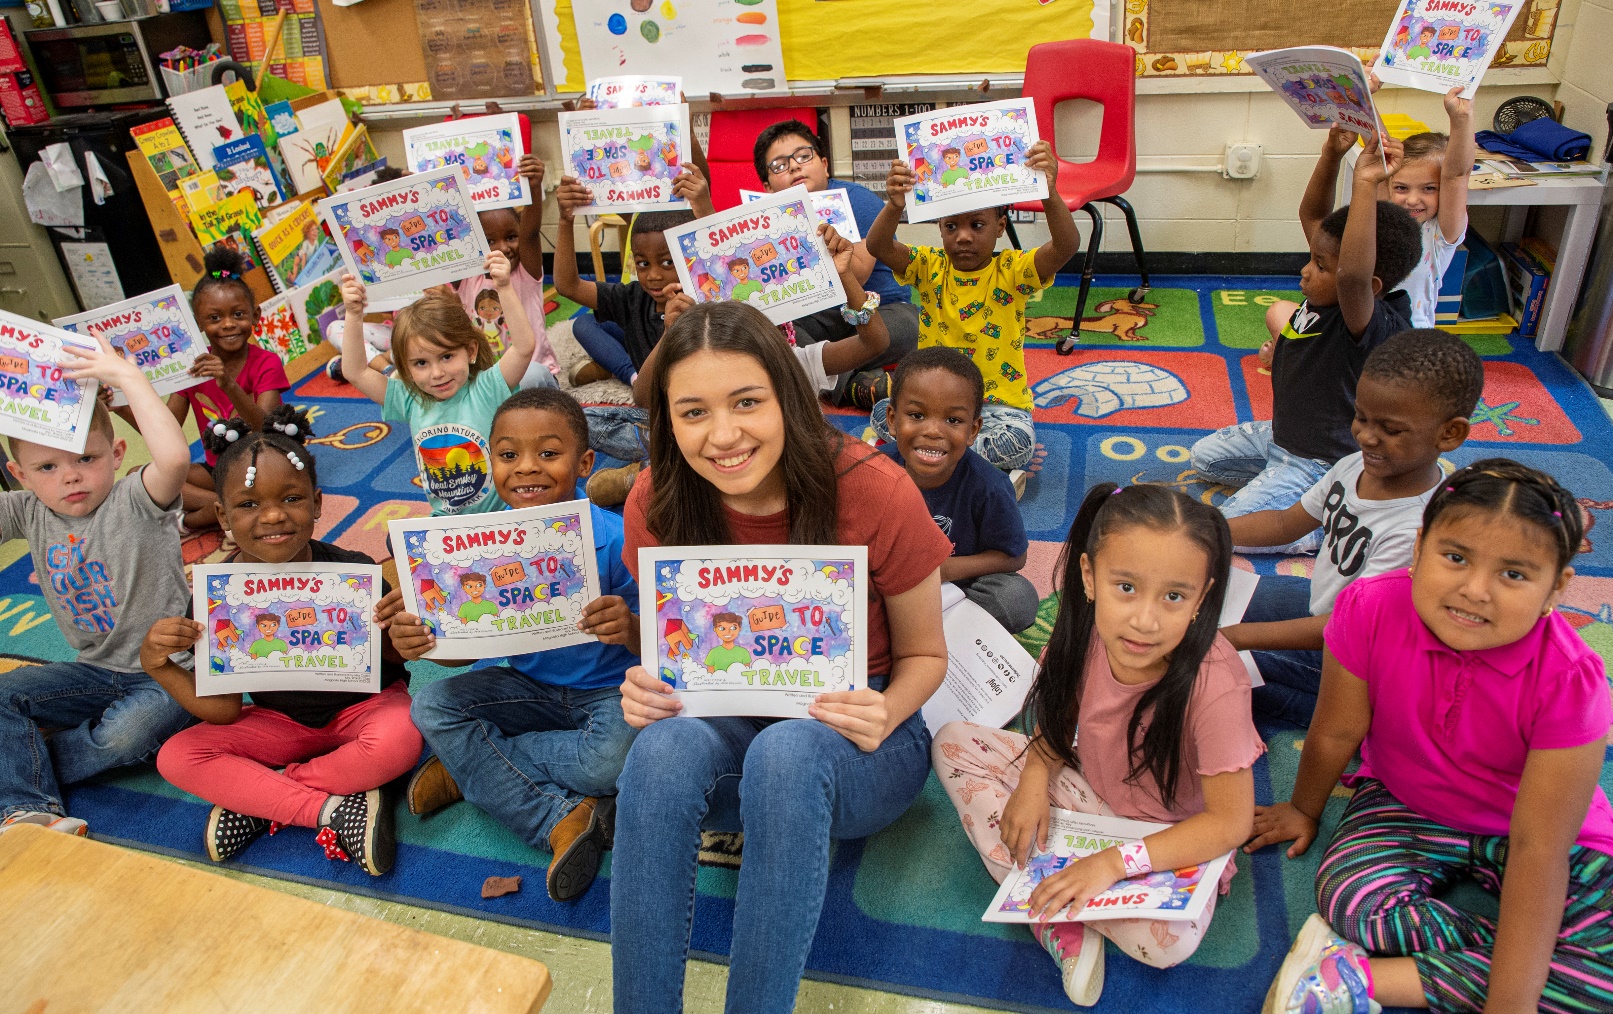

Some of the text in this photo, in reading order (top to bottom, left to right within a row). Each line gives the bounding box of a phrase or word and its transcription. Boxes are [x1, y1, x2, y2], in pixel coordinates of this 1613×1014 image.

[1425, 0, 1477, 16] SAMMY'S
[1463, 28, 1481, 41] TO
[1432, 42, 1473, 58] SPACE
[1420, 62, 1461, 76] TRAVEL
[854, 104, 931, 117] NUMBERS 1-100
[584, 127, 633, 140] TRAVEL
[931, 115, 989, 137] SAMMY'S
[137, 134, 156, 144] Creepy
[425, 136, 470, 152] TRAVEL
[991, 135, 1012, 149] TO
[586, 145, 627, 160] SPACE
[969, 153, 1014, 171] SPACE
[588, 166, 606, 179] TO
[963, 173, 1018, 191] TRAVEL
[607, 185, 661, 202] SAMMY'S
[360, 189, 420, 218] SAMMY'S
[226, 209, 244, 220] Grass
[427, 209, 449, 226] TO
[816, 209, 832, 217] TO
[268, 207, 312, 250] QUICK AS A CRICKET
[708, 215, 771, 247] SAMMY'S
[410, 228, 456, 251] SPACE
[778, 236, 799, 252] TO
[410, 249, 464, 271] TRAVEL
[760, 256, 807, 283] SPACE
[759, 279, 815, 305] TRAVEL
[959, 300, 980, 315] SUPER
[150, 326, 171, 340] TO
[136, 342, 178, 366] SPACE
[36, 364, 63, 382] TO
[146, 361, 187, 381] RAVEL
[452, 426, 480, 443] NATURE
[1100, 436, 1192, 463] Oo
[448, 474, 477, 489] Smoky
[1322, 480, 1373, 578] BRO
[442, 528, 527, 554] SAMMY'S
[530, 556, 558, 576] TO
[48, 560, 113, 595] OUR
[698, 565, 793, 588] SAMMY'S
[244, 577, 323, 596] SAMMY'S
[499, 582, 562, 607] SPACE
[56, 583, 119, 616] ISH
[73, 609, 116, 633] ON
[322, 608, 347, 624] TO
[491, 609, 566, 632] TRAVEL
[793, 606, 823, 626] TO
[289, 630, 347, 646] SPACE
[753, 635, 823, 656] SPACE
[280, 655, 348, 669] TRAVEL
[741, 669, 825, 687] TRAVEL
[986, 678, 1003, 696] Enjoy!
[1087, 893, 1149, 908] SAMM
